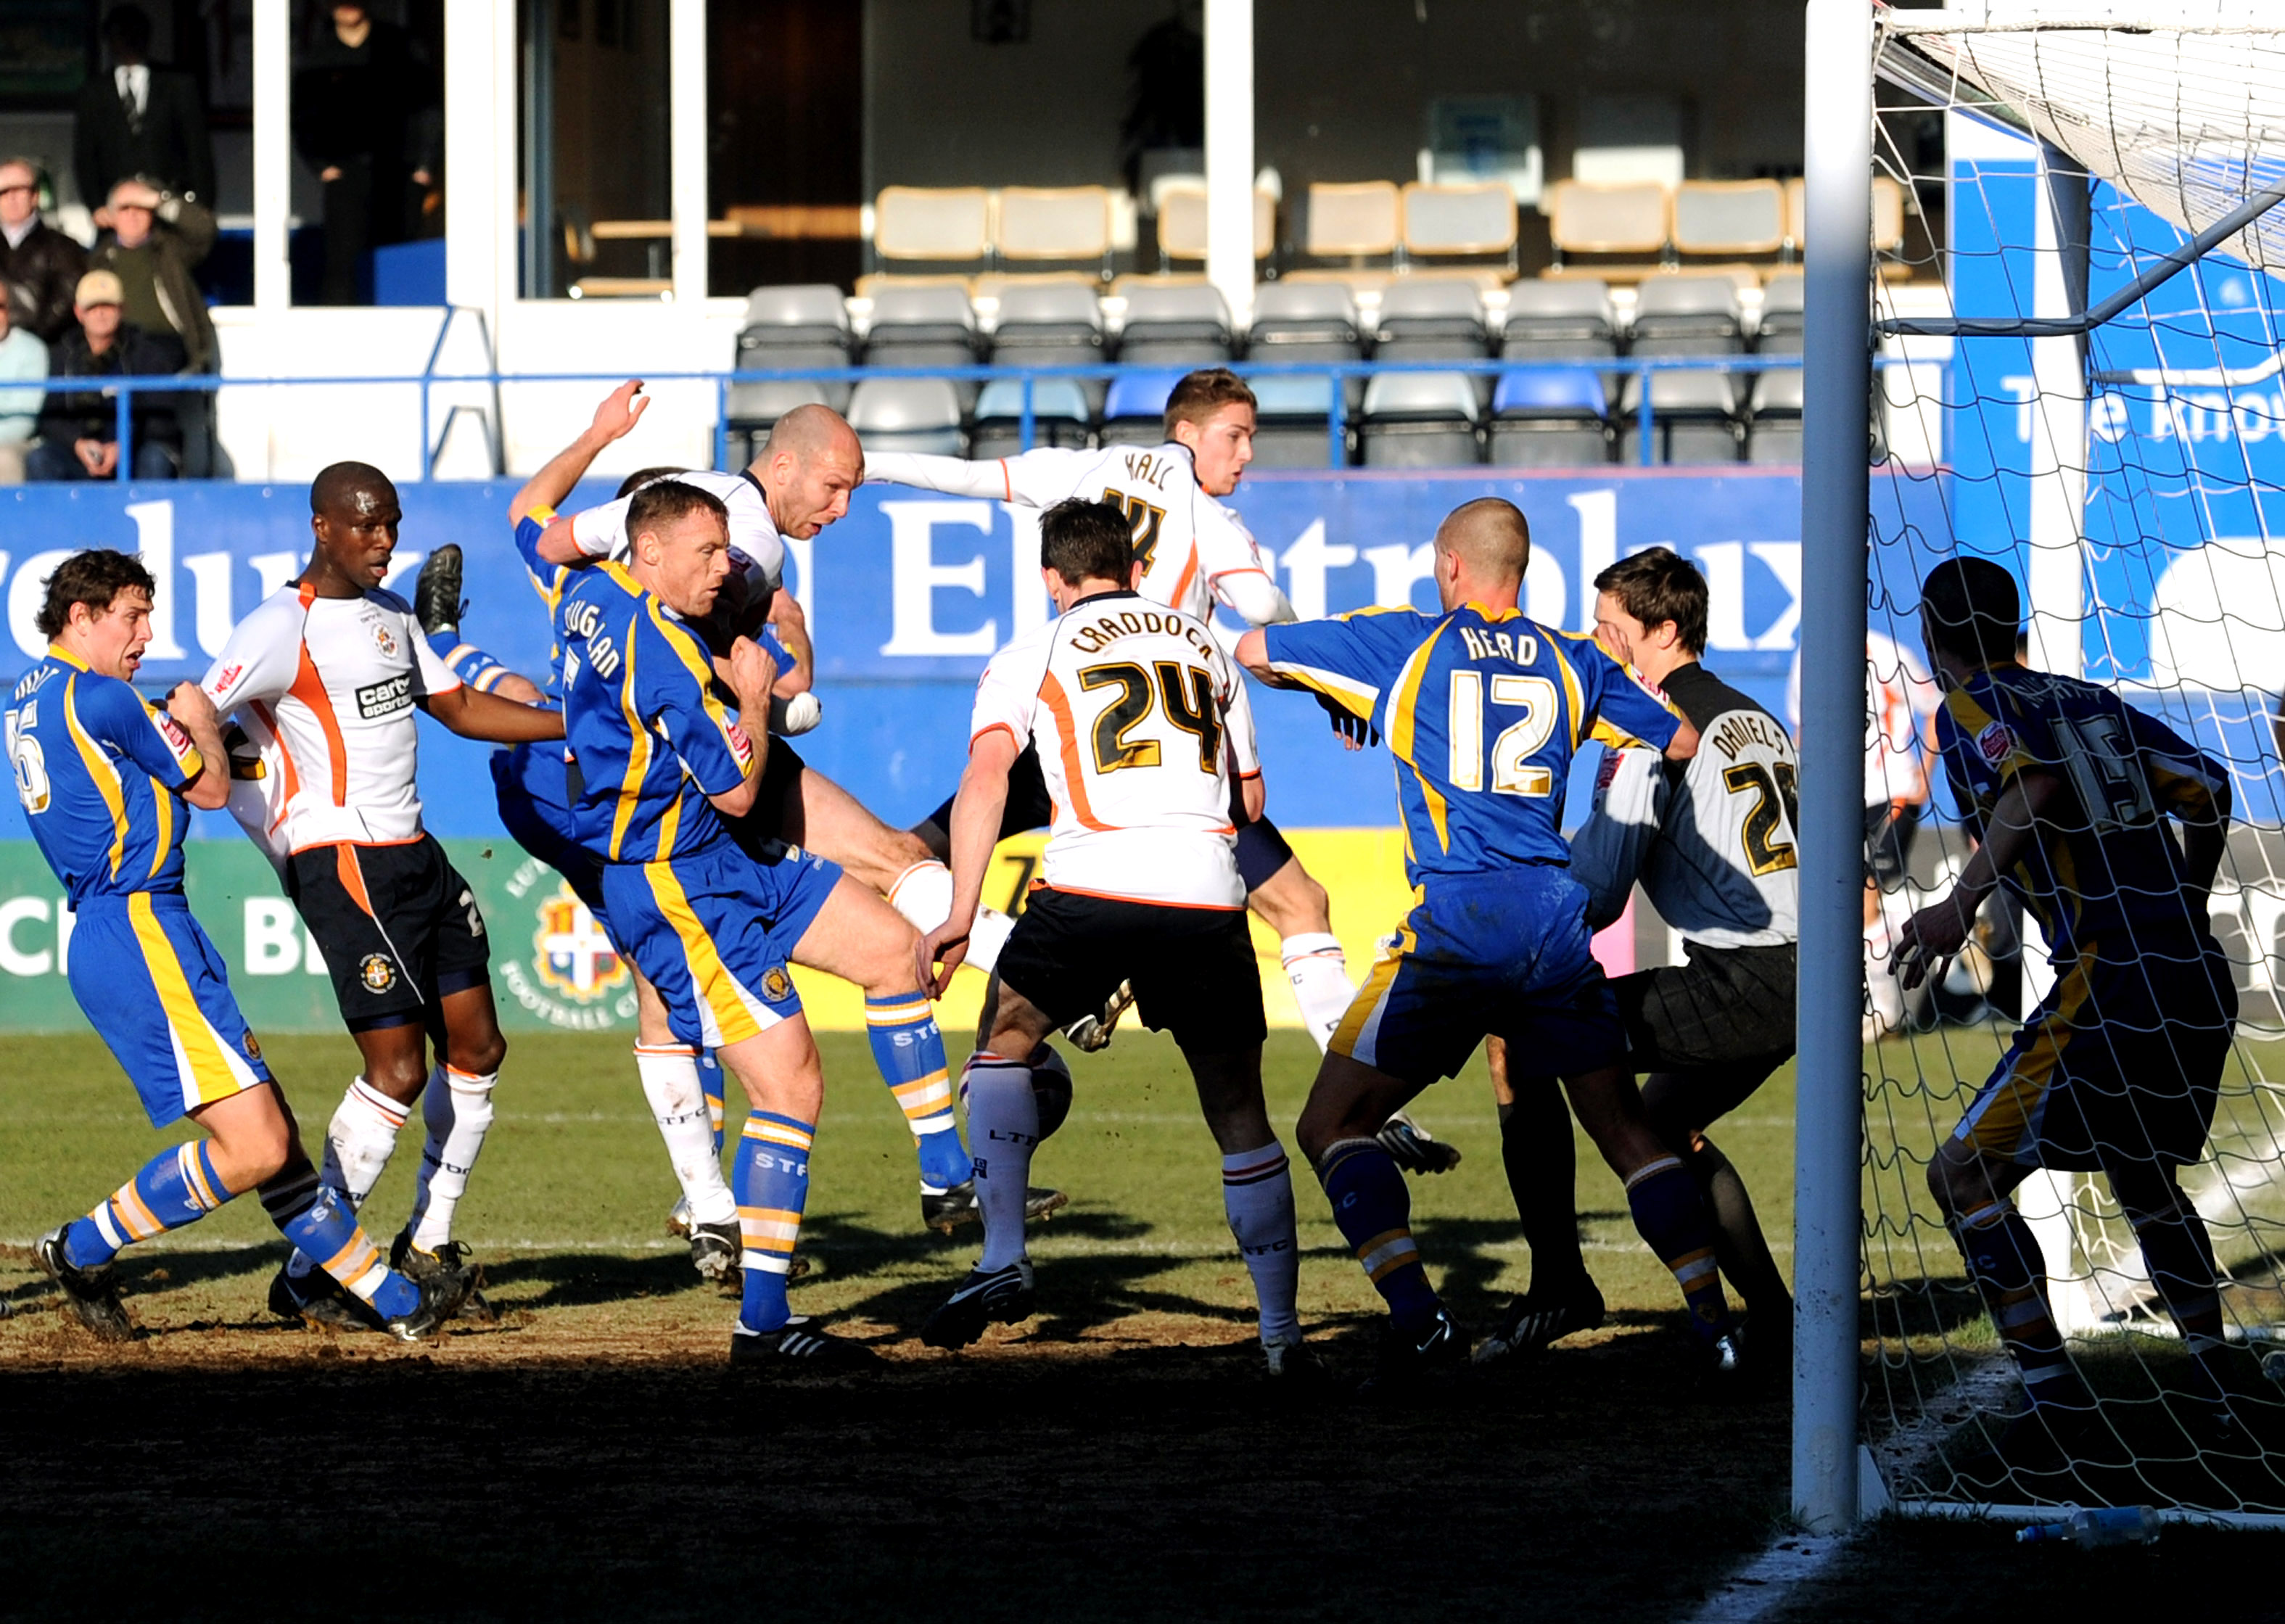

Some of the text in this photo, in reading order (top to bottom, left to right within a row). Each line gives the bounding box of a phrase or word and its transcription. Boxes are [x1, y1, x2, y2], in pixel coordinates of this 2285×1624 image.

[2001, 376, 2285, 445] Te kno
[1459, 626, 1538, 666] HERD
[1076, 660, 1223, 777] 24
[1448, 669, 1559, 799] 12
[1712, 715, 1784, 762] DANIELS
